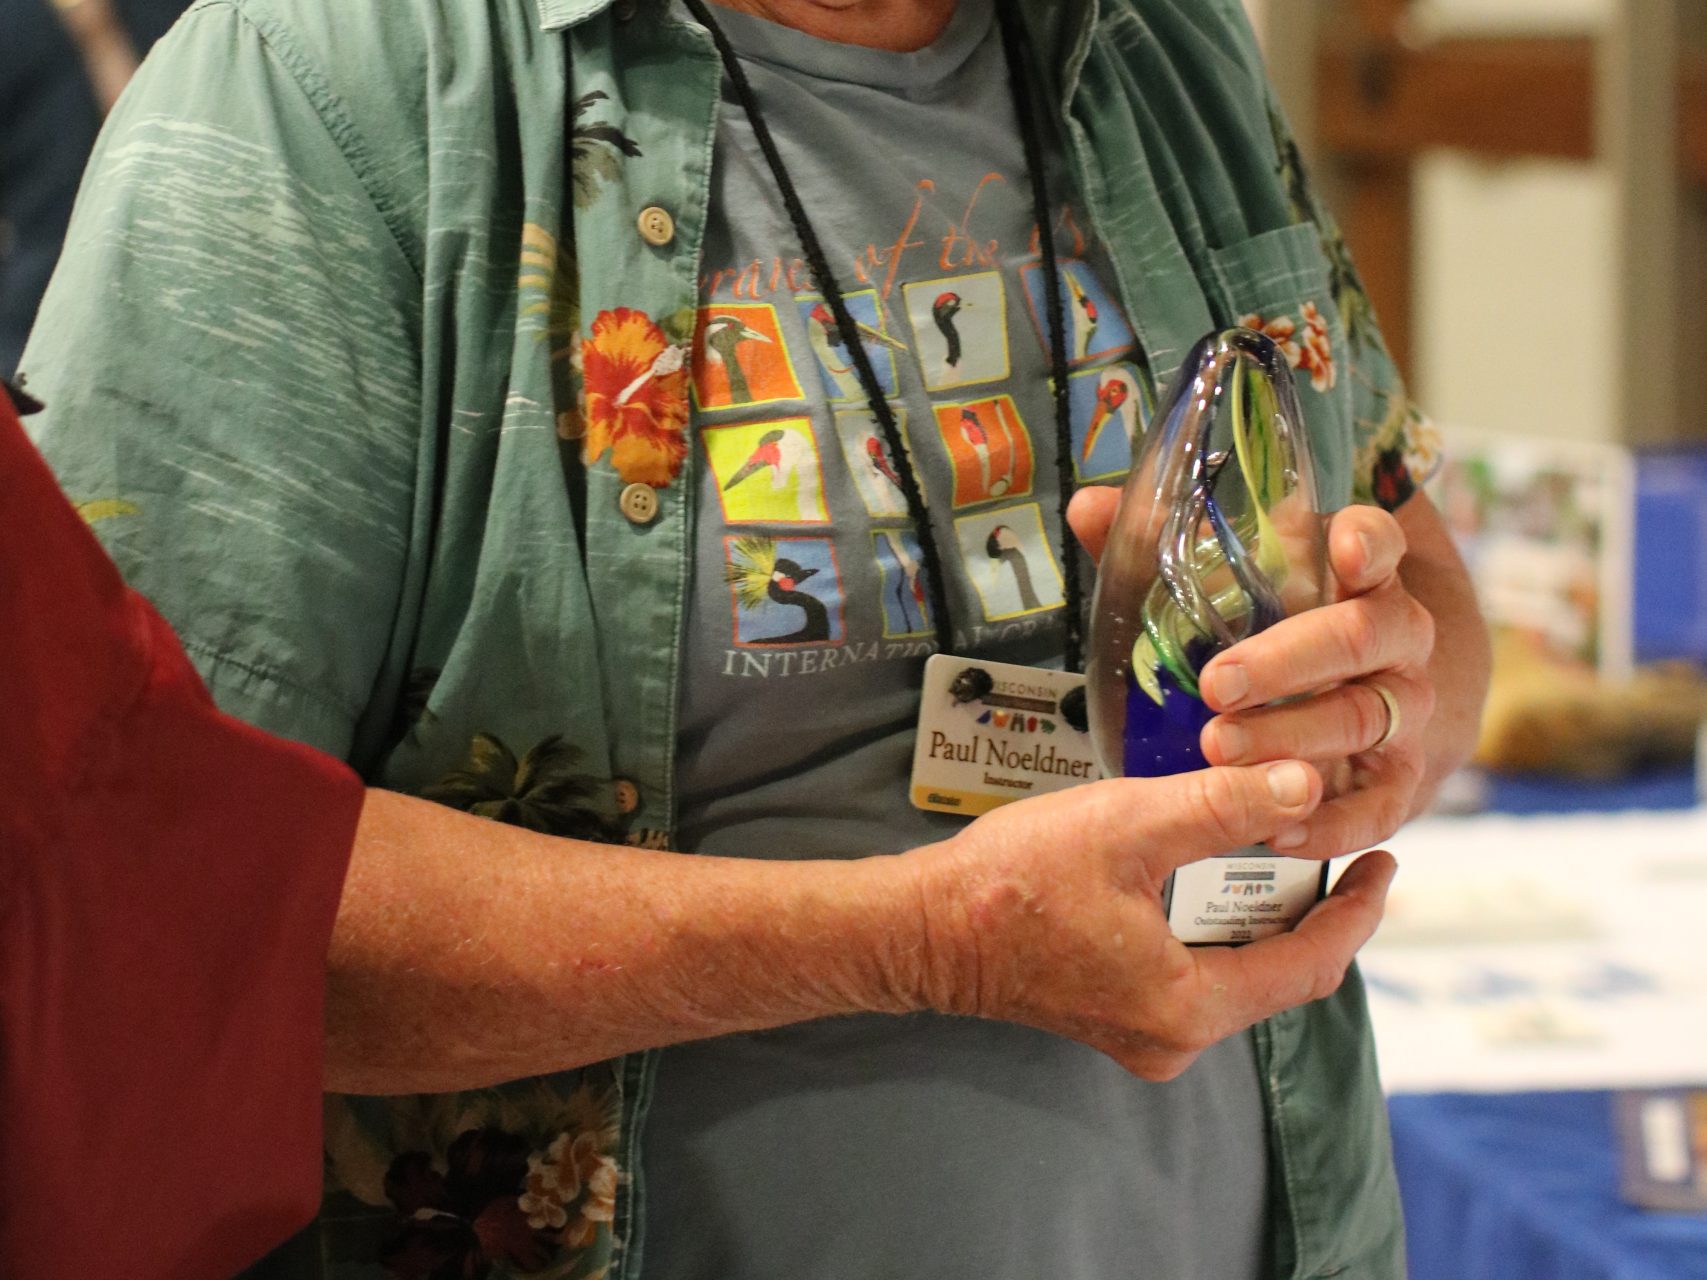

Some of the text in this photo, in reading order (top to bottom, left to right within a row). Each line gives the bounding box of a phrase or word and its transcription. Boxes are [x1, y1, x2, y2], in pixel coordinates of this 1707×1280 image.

[854, 179, 935, 324] of
[939, 171, 1007, 270] the
[993, 680, 1057, 698] ISCONSIN
[929, 731, 1094, 779] Paul Noeldner
[1205, 900, 1283, 913] Paul Noeldner
